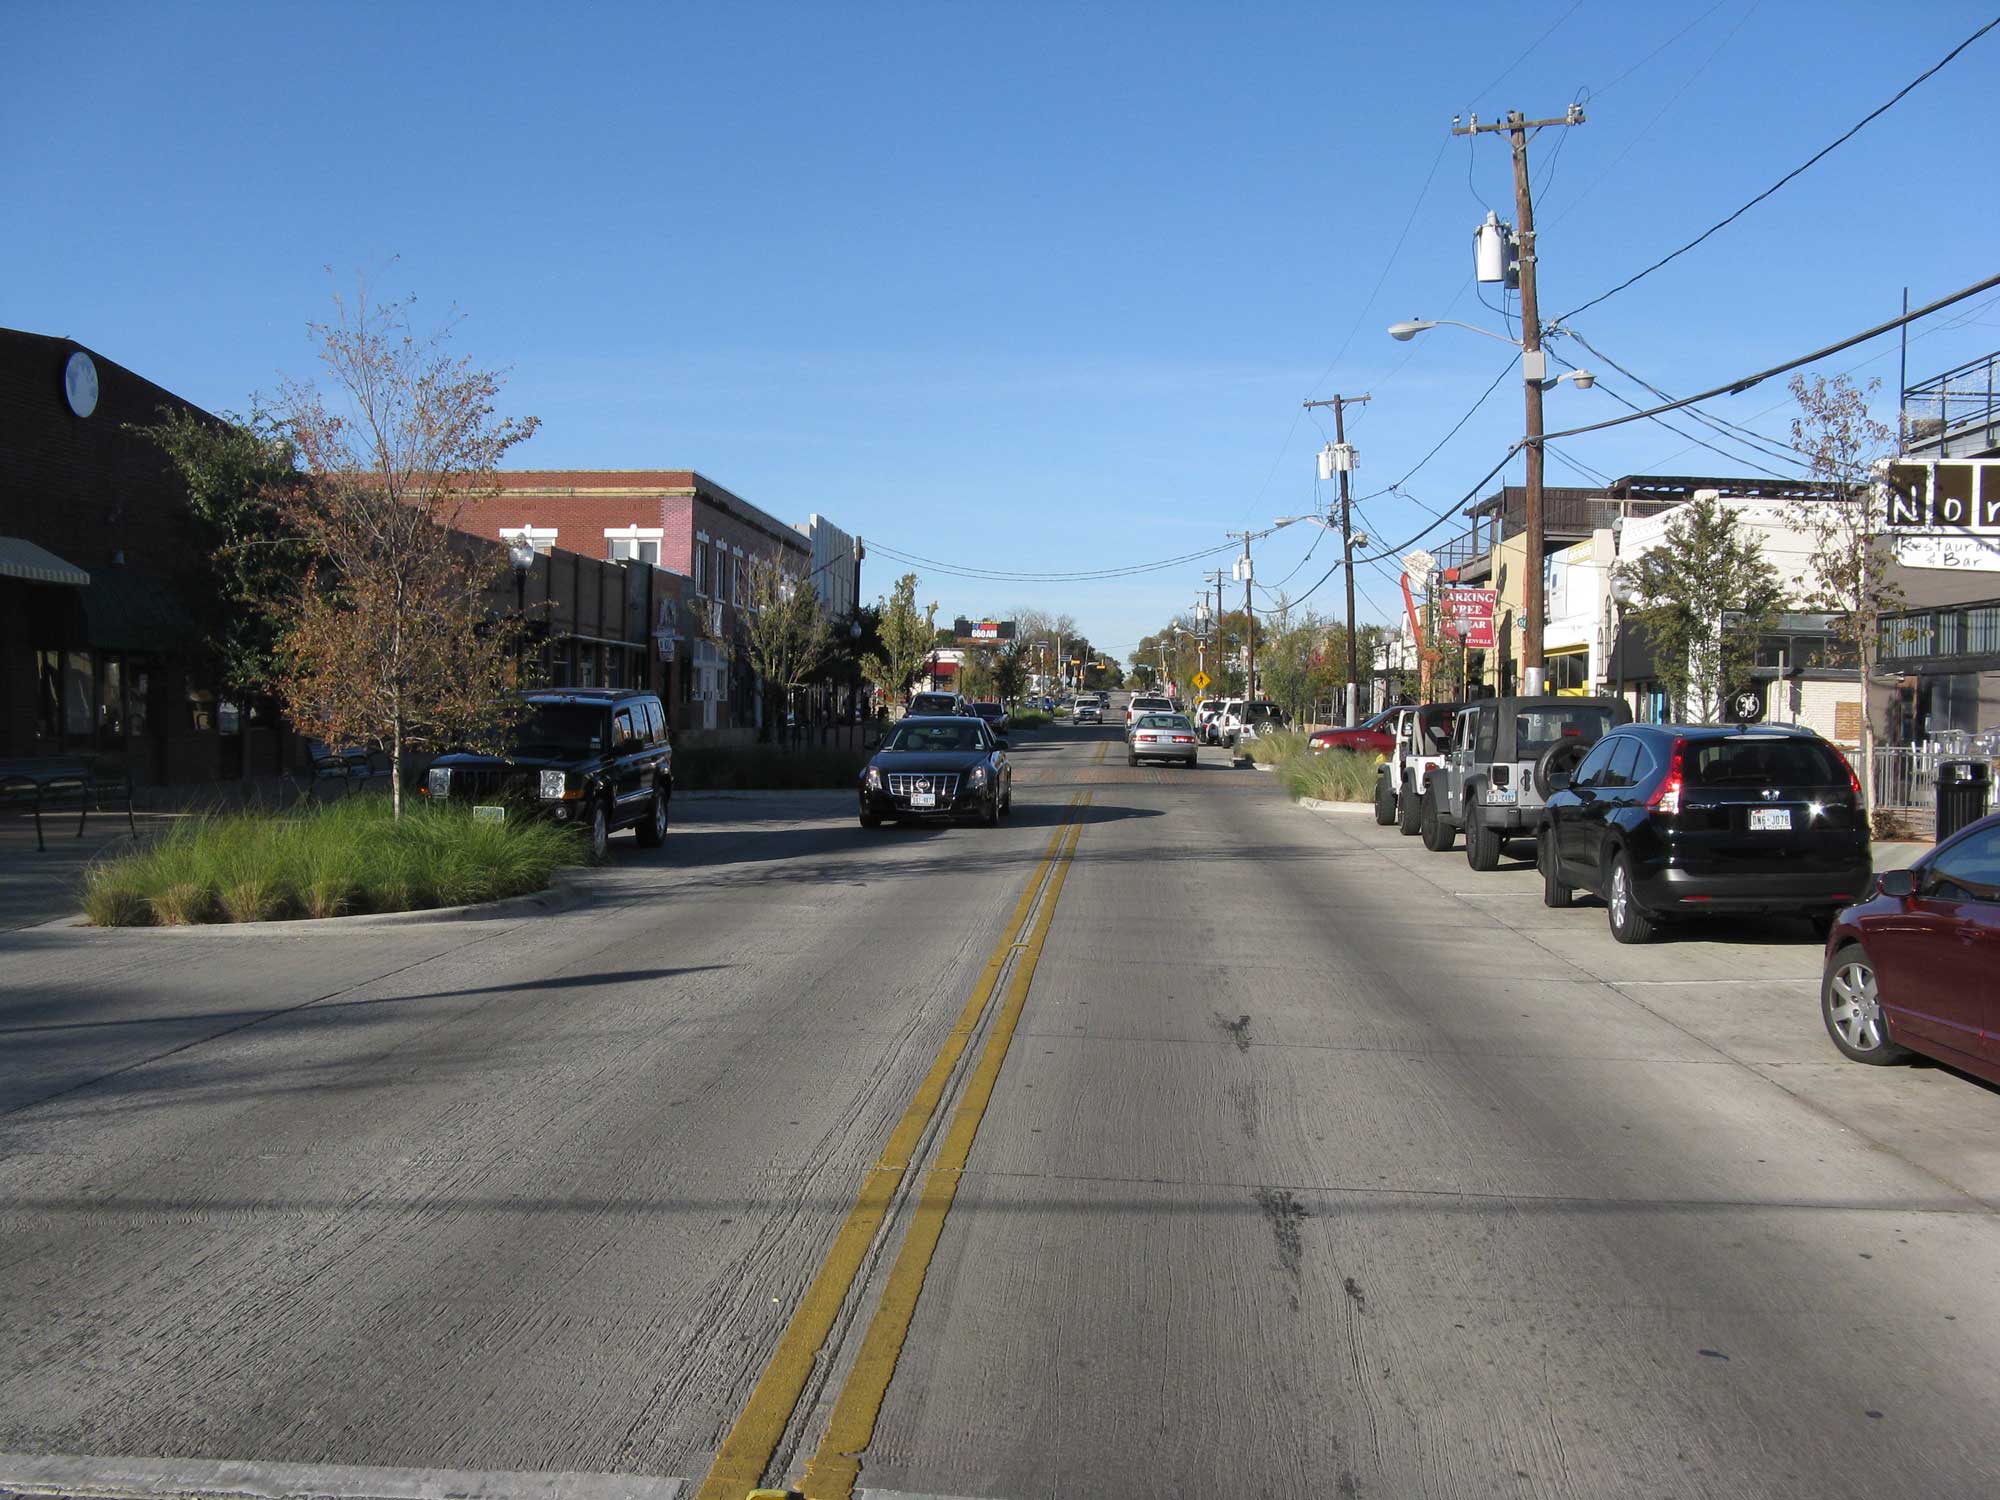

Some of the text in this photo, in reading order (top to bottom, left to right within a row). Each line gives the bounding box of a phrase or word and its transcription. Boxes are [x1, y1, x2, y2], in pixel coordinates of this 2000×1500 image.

[1894, 485, 2000, 523] Nor
[1944, 553, 1982, 566] Bar
[1442, 592, 1494, 602] ARKING
[972, 629, 997, 637] 660 AM
